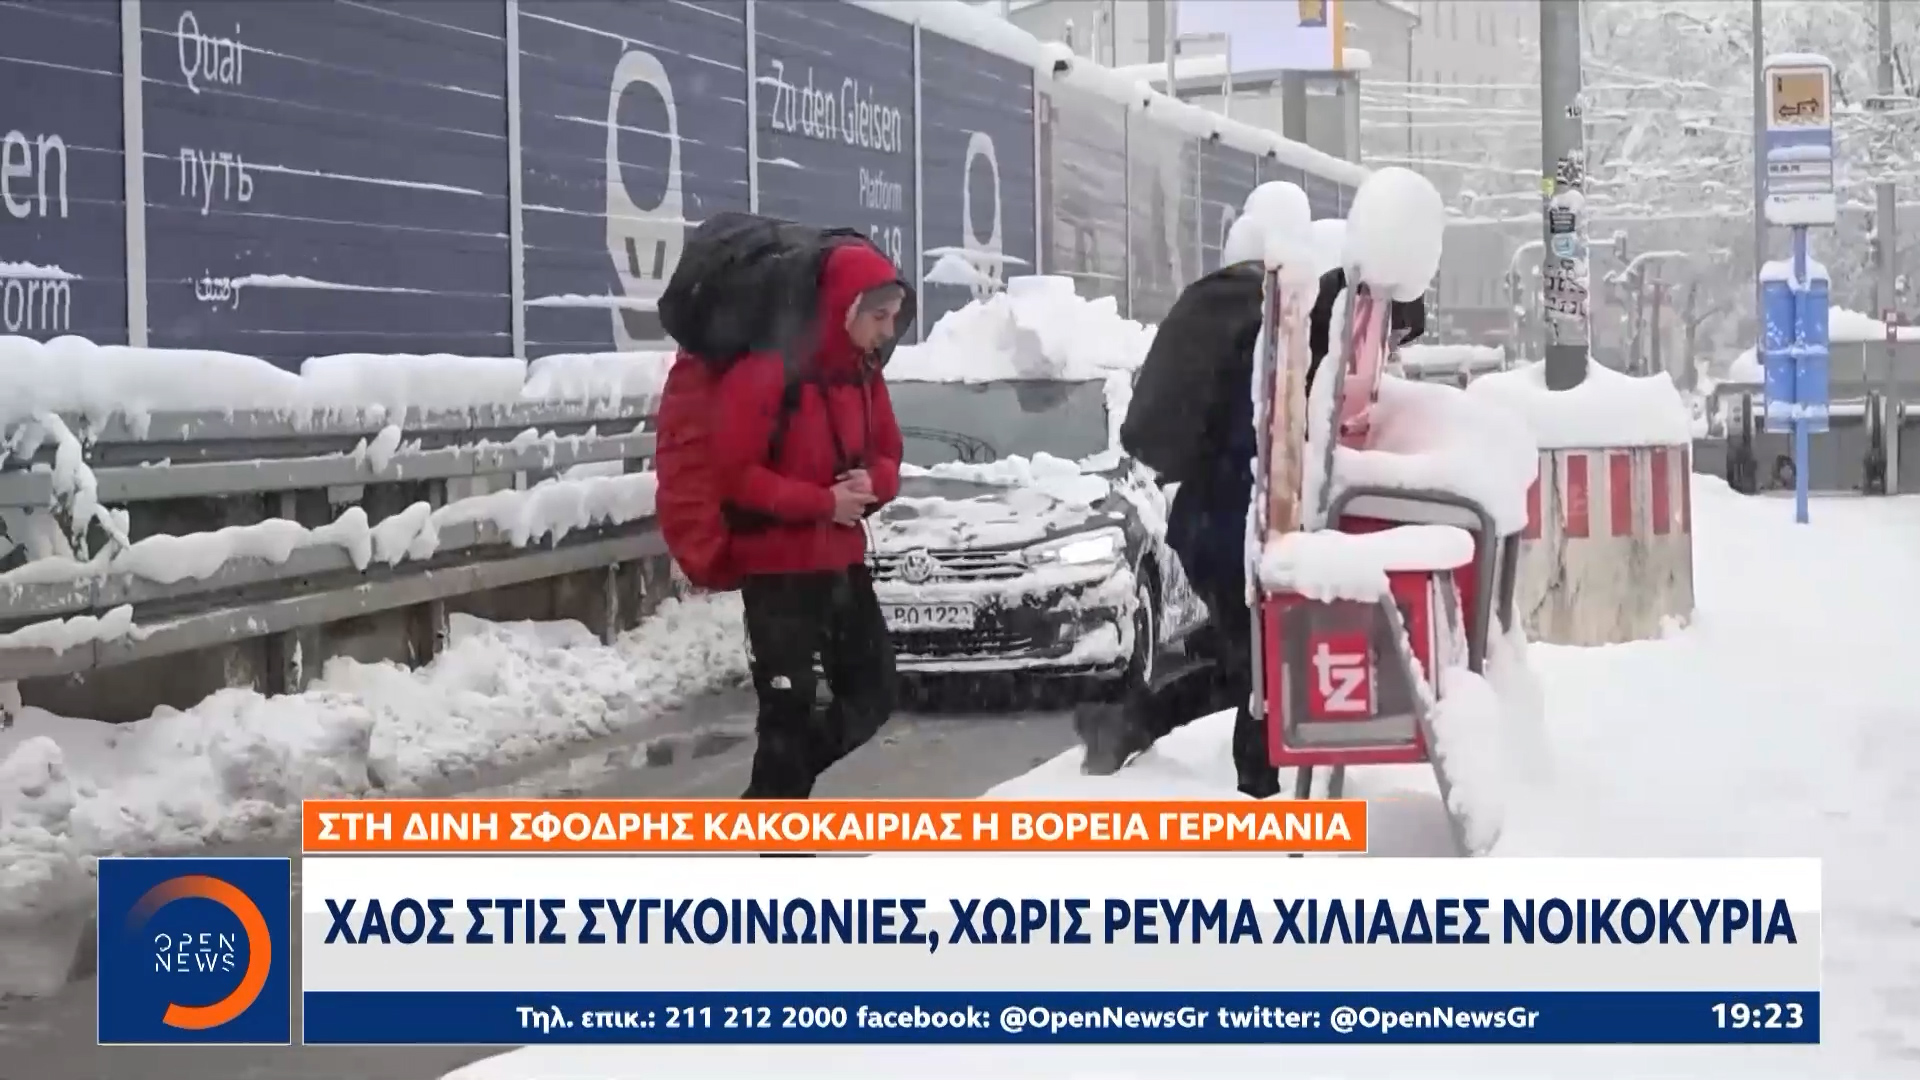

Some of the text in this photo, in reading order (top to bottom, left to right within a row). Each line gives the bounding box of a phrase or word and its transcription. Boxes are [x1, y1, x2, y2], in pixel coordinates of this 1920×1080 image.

[177, 10, 243, 93] Quai
[771, 59, 901, 153] Zu den Gleisen
[180, 147, 254, 216] путь
[859, 166, 903, 211] Platform
